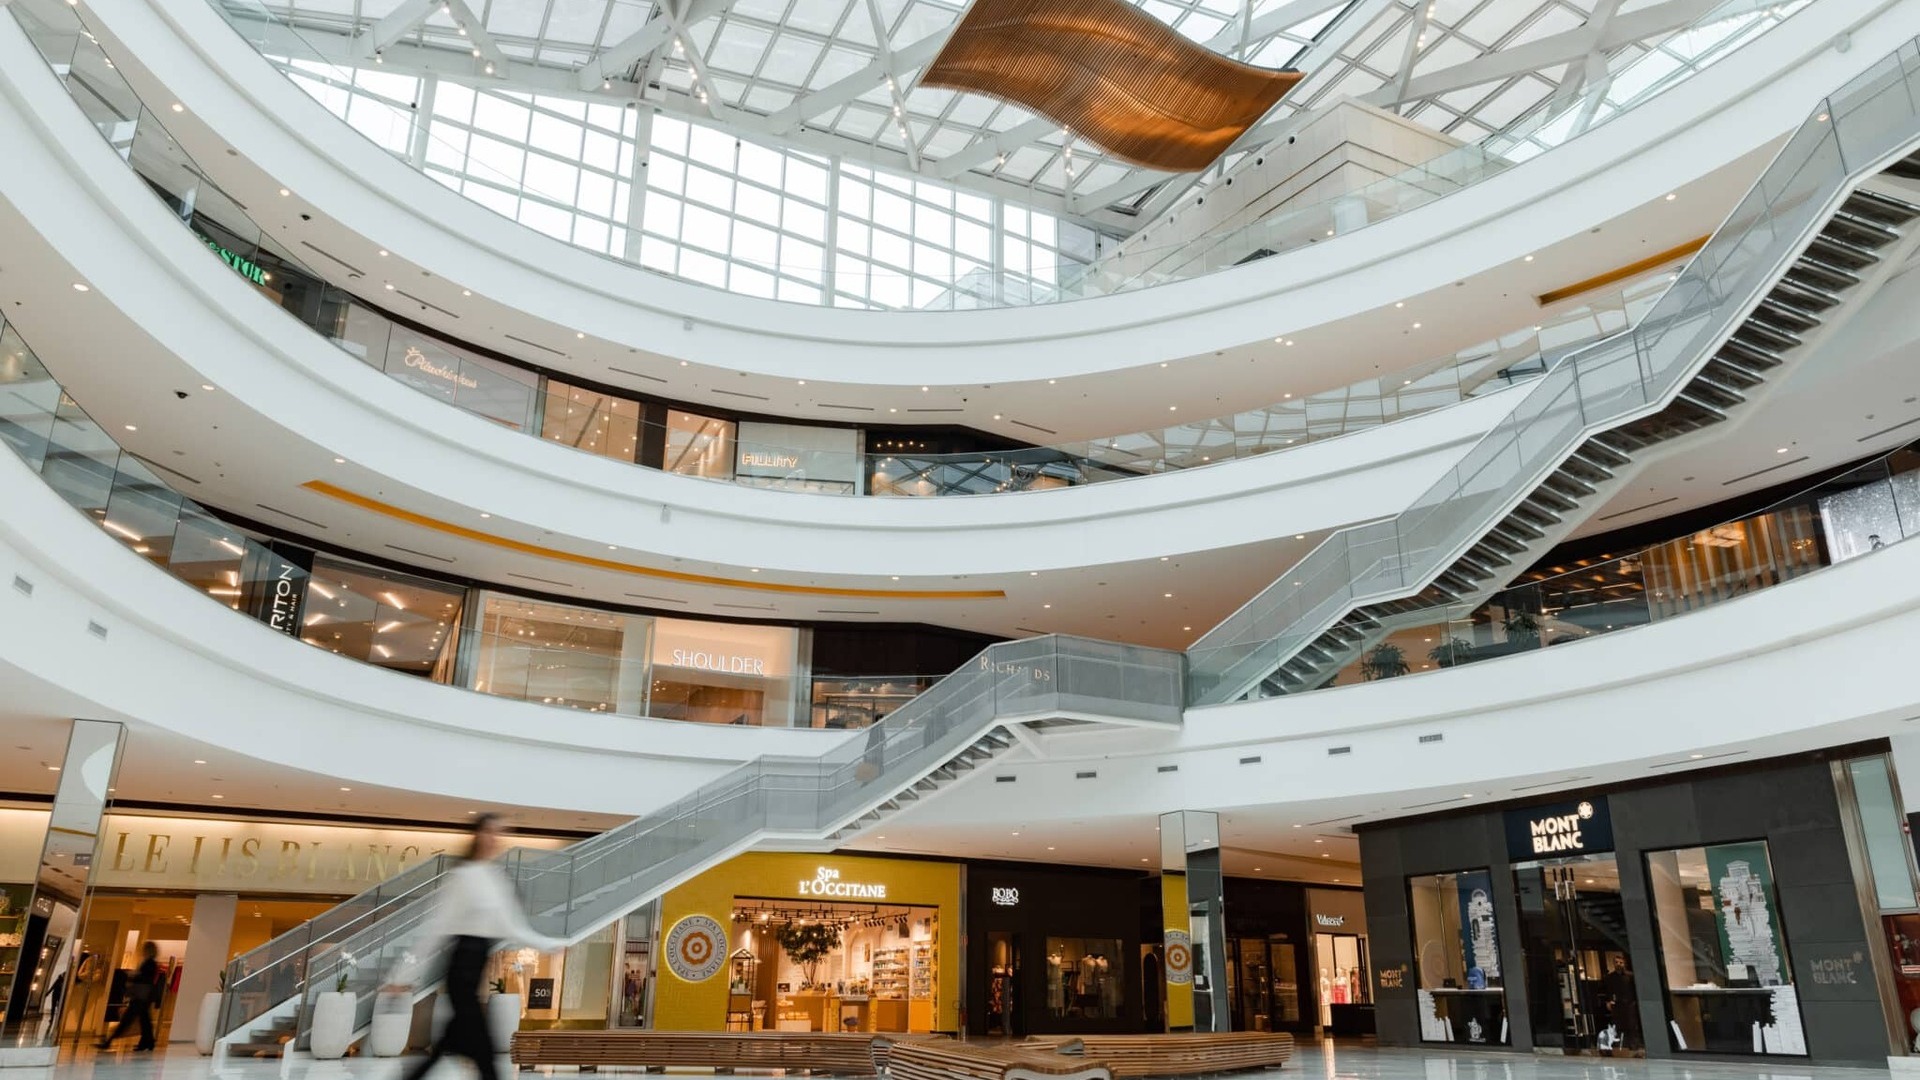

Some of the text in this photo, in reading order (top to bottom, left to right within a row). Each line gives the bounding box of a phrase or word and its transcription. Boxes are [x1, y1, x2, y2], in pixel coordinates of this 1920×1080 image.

[742, 453, 797, 468] FILLITY
[270, 564, 294, 629] RITON
[673, 649, 764, 675] SHOULDER
[1530, 814, 1580, 836] MONT
[108, 832, 171, 874] LE
[1532, 831, 1584, 853] BLANC
[817, 866, 840, 882] Spa
[799, 880, 886, 898] L'OCCITANE
[1808, 959, 1852, 972] MONT
